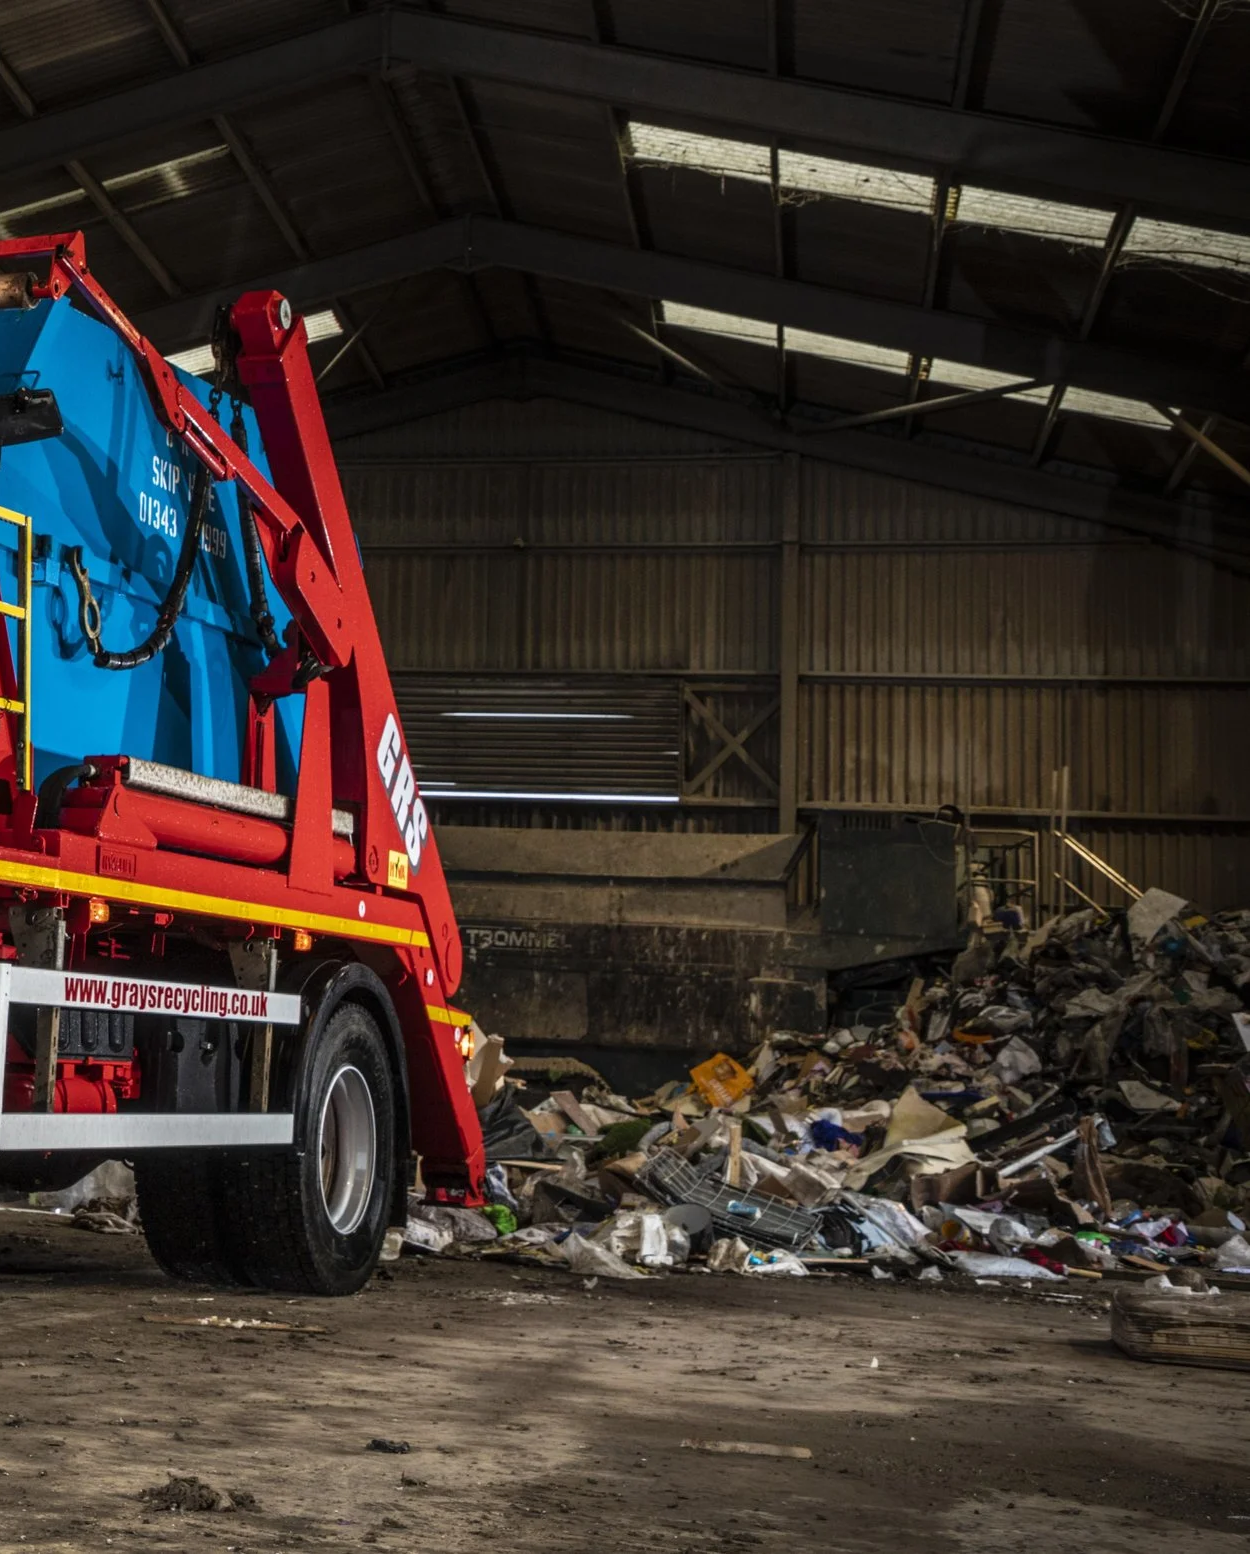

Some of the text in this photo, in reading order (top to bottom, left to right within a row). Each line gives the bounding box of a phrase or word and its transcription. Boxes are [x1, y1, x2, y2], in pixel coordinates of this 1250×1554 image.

[152, 455, 180, 494] SKIP
[139, 491, 177, 537] 01343
[377, 713, 427, 874] GRS
[64, 977, 268, 1017] www.graysrecycling.co.uk
